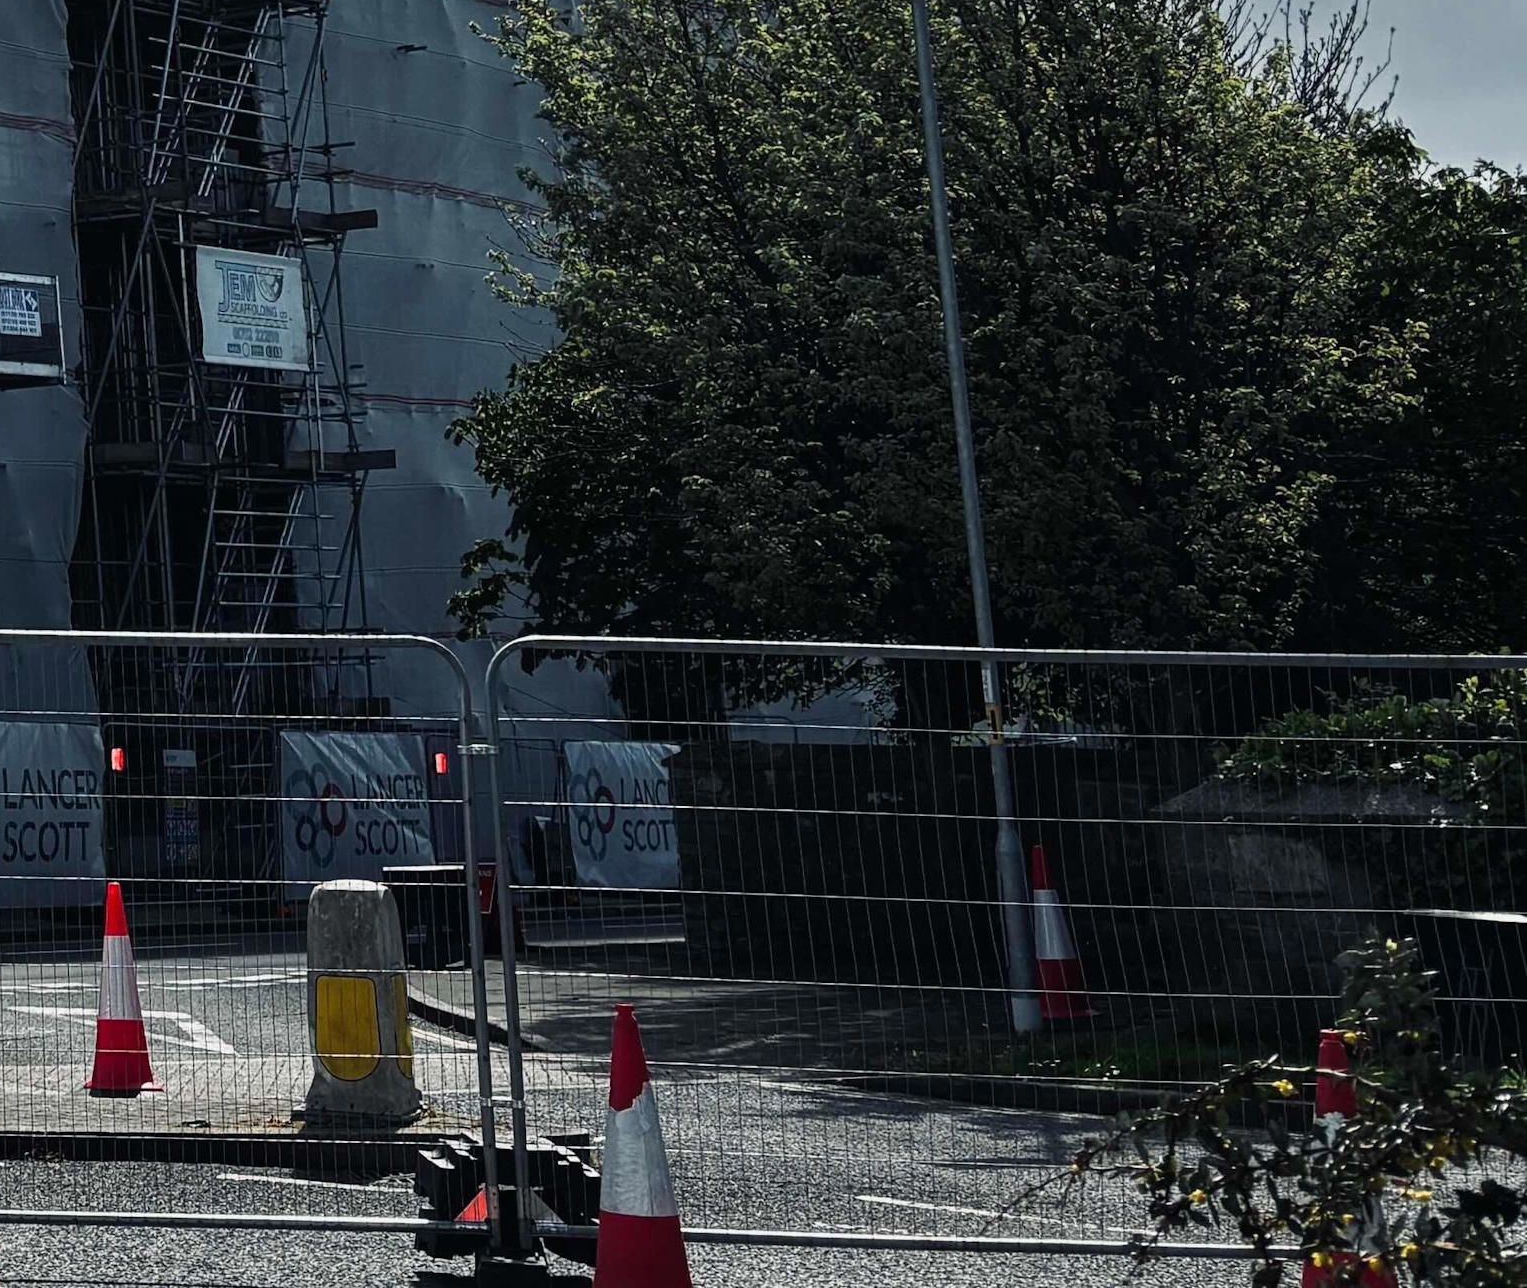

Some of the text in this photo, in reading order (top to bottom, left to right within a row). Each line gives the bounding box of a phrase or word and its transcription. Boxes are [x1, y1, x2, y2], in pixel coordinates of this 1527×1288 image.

[230, 302, 278, 317] SCAFFOLDING
[2, 768, 100, 810] LANCER
[351, 774, 427, 810] LANCER
[2, 821, 91, 863] SCOTT
[354, 819, 420, 856] SCOTT
